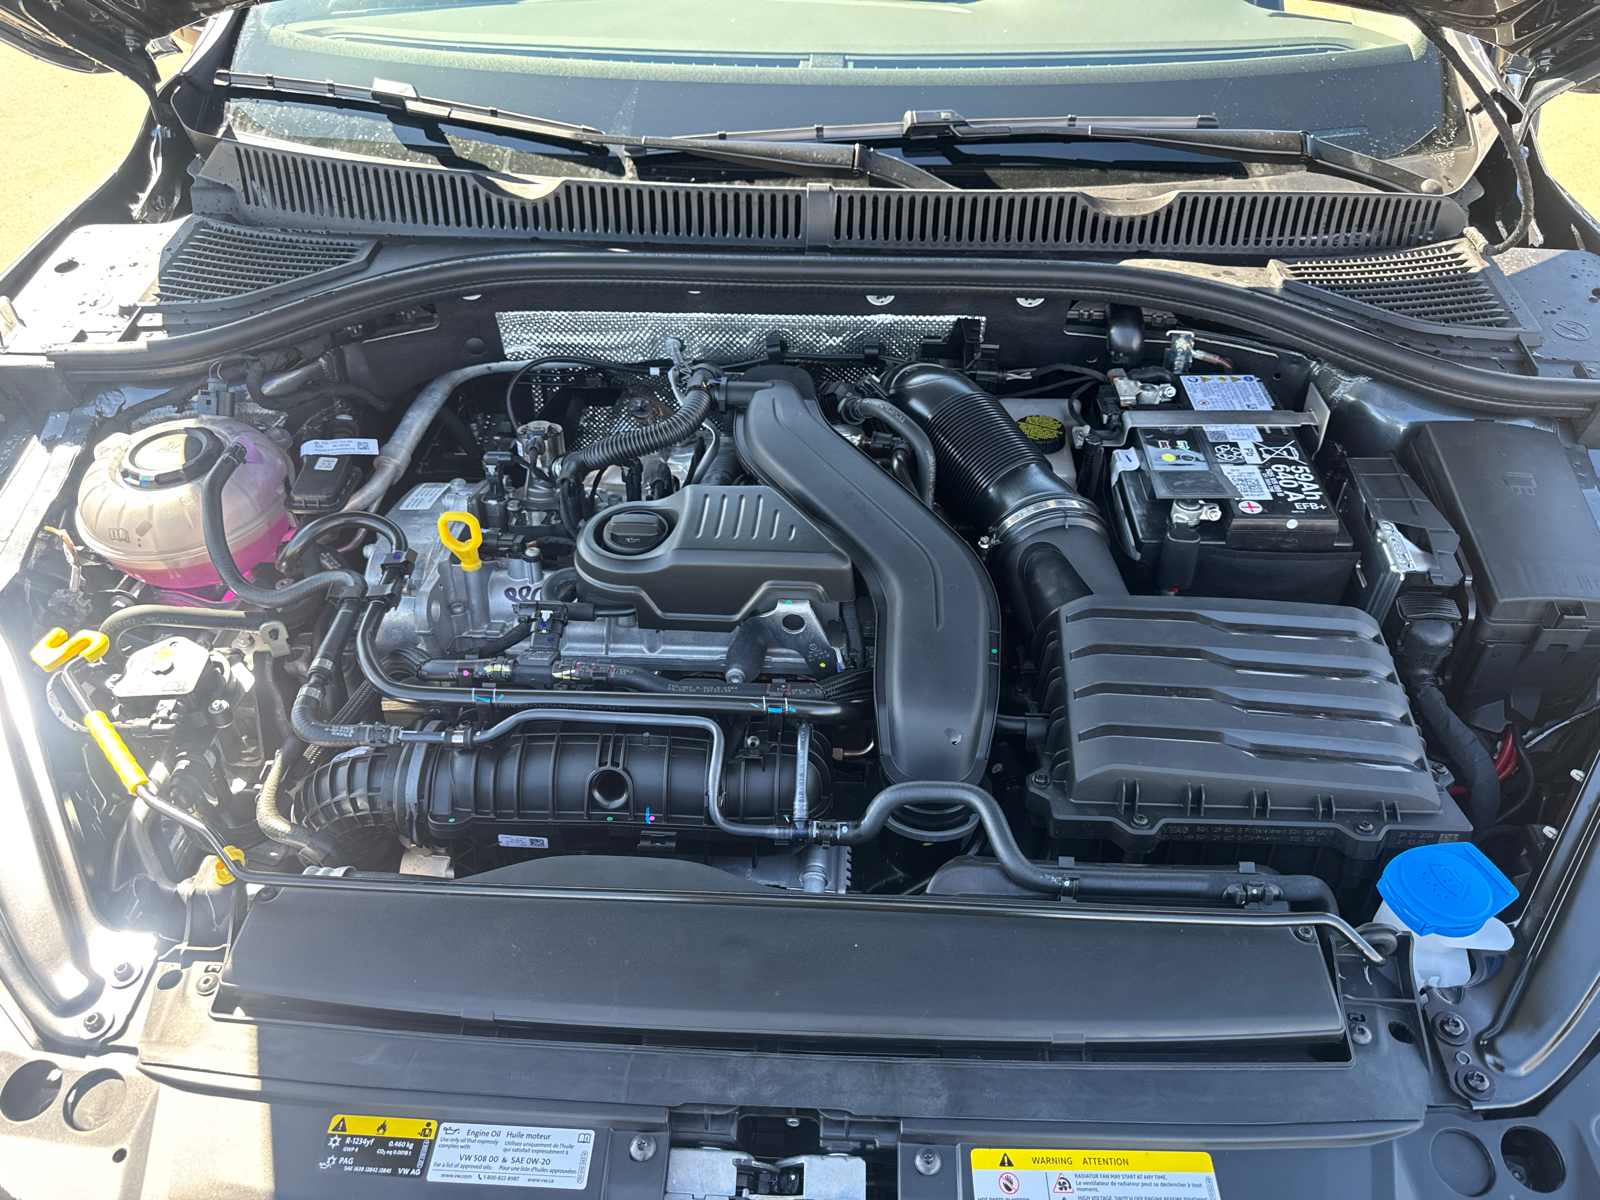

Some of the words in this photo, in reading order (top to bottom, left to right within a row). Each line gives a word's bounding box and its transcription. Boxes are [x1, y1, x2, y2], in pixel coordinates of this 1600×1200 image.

[1244, 448, 1254, 456] Pb
[1271, 464, 1298, 488] 640
[1290, 466, 1323, 500] 59Ah
[1284, 491, 1306, 502] A
[467, 1129, 490, 1138] Engine
[506, 1131, 524, 1139] Huile
[345, 1137, 375, 1147] R-1234yf
[406, 1141, 414, 1149] kg
[1032, 1157, 1073, 1165] WARNING
[1082, 1158, 1129, 1166] ATTENTION
